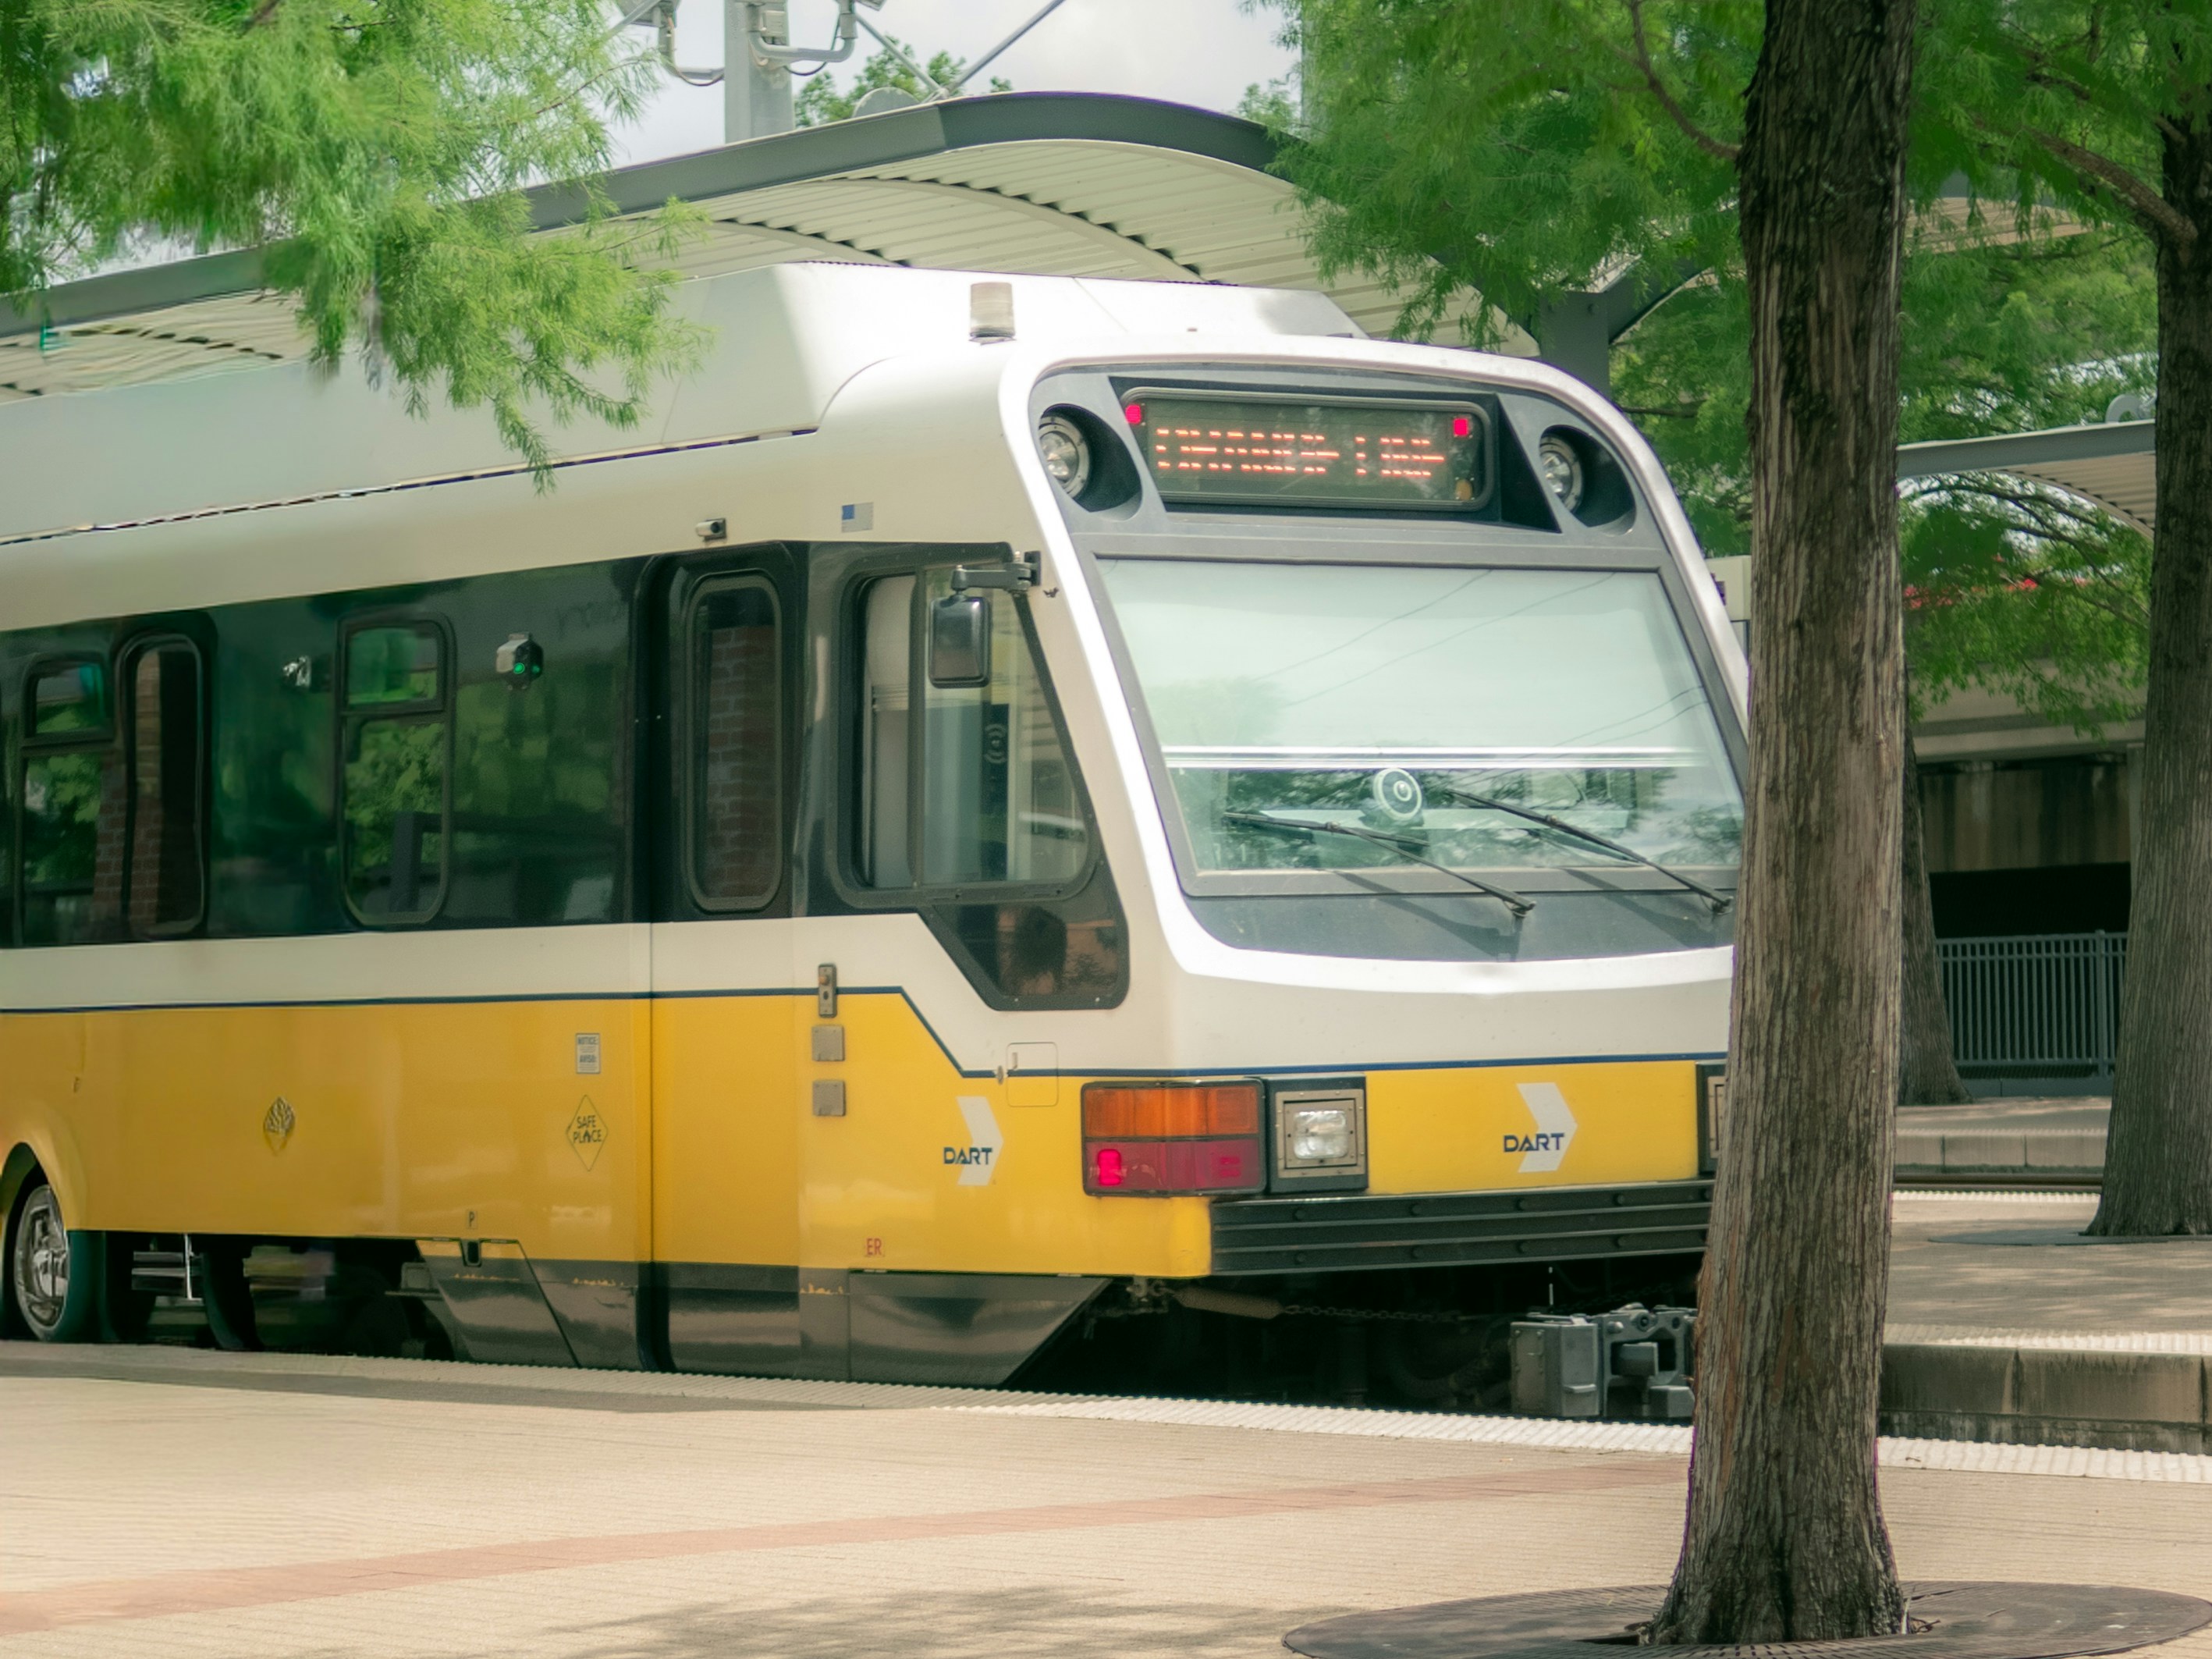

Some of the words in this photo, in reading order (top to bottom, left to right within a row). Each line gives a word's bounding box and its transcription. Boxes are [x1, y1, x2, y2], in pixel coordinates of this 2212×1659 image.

[577, 1114, 597, 1129] SAFE
[1503, 1132, 1565, 1153] DART
[943, 1146, 993, 1165] DART
[866, 1238, 882, 1256] ER
